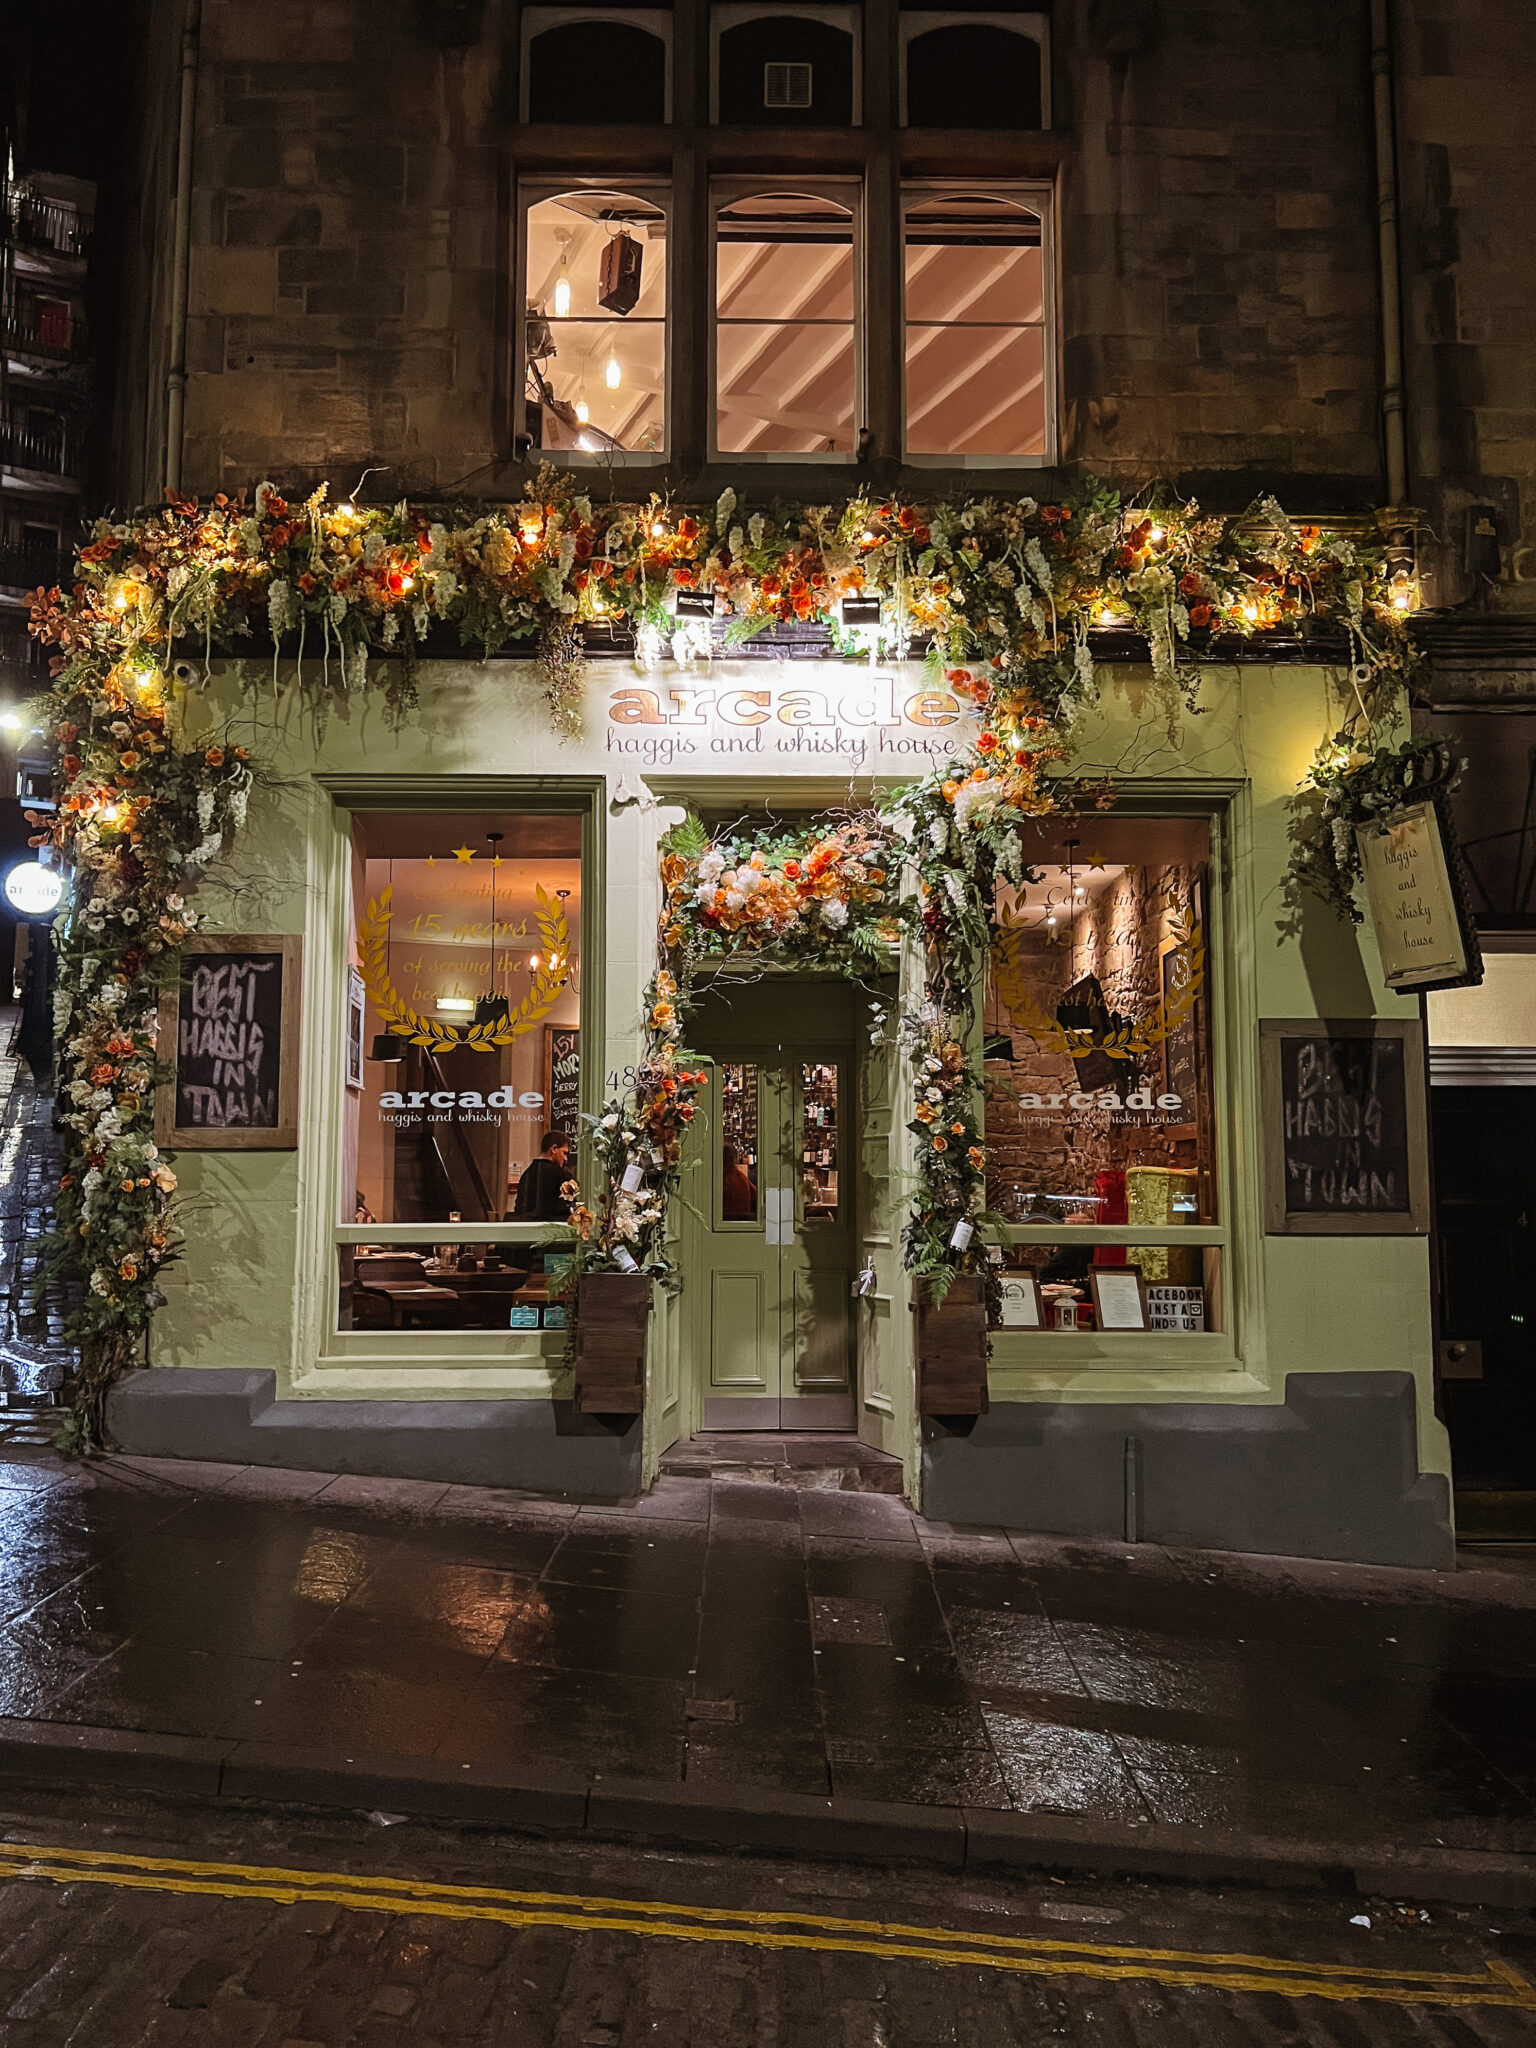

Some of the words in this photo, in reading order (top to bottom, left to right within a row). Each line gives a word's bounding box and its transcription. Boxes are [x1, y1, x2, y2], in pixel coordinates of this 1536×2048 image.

[608, 677, 960, 726] arcade
[606, 727, 698, 765] haggis
[710, 727, 765, 754] and
[775, 727, 869, 765] whisky
[879, 727, 958, 756] house
[1384, 845, 1418, 870] haggis
[1398, 874, 1417, 892] and
[1395, 898, 1432, 924] whisky
[407, 913, 443, 938] 15
[452, 917, 528, 944] years
[1404, 930, 1436, 949] house
[403, 953, 425, 976] of
[496, 952, 522, 972] the
[192, 960, 275, 1024] BEST
[212, 1059, 245, 1087] IN
[605, 1065, 636, 1091] 48
[182, 1082, 275, 1127] TOWN
[379, 1085, 545, 1109] arcade
[1018, 1087, 1183, 1110] arcade
[378, 1109, 422, 1127] haggis
[427, 1109, 453, 1122] and
[458, 1109, 502, 1127] whisky
[507, 1110, 544, 1122] house
[1099, 1111, 1141, 1128] hisky
[1145, 1111, 1183, 1124] house
[1287, 1157, 1395, 1206] TOWN
[1148, 1288, 1202, 1301] ACEBOOK
[1151, 1318, 1169, 1329] IND
[1182, 1318, 1196, 1330] US
